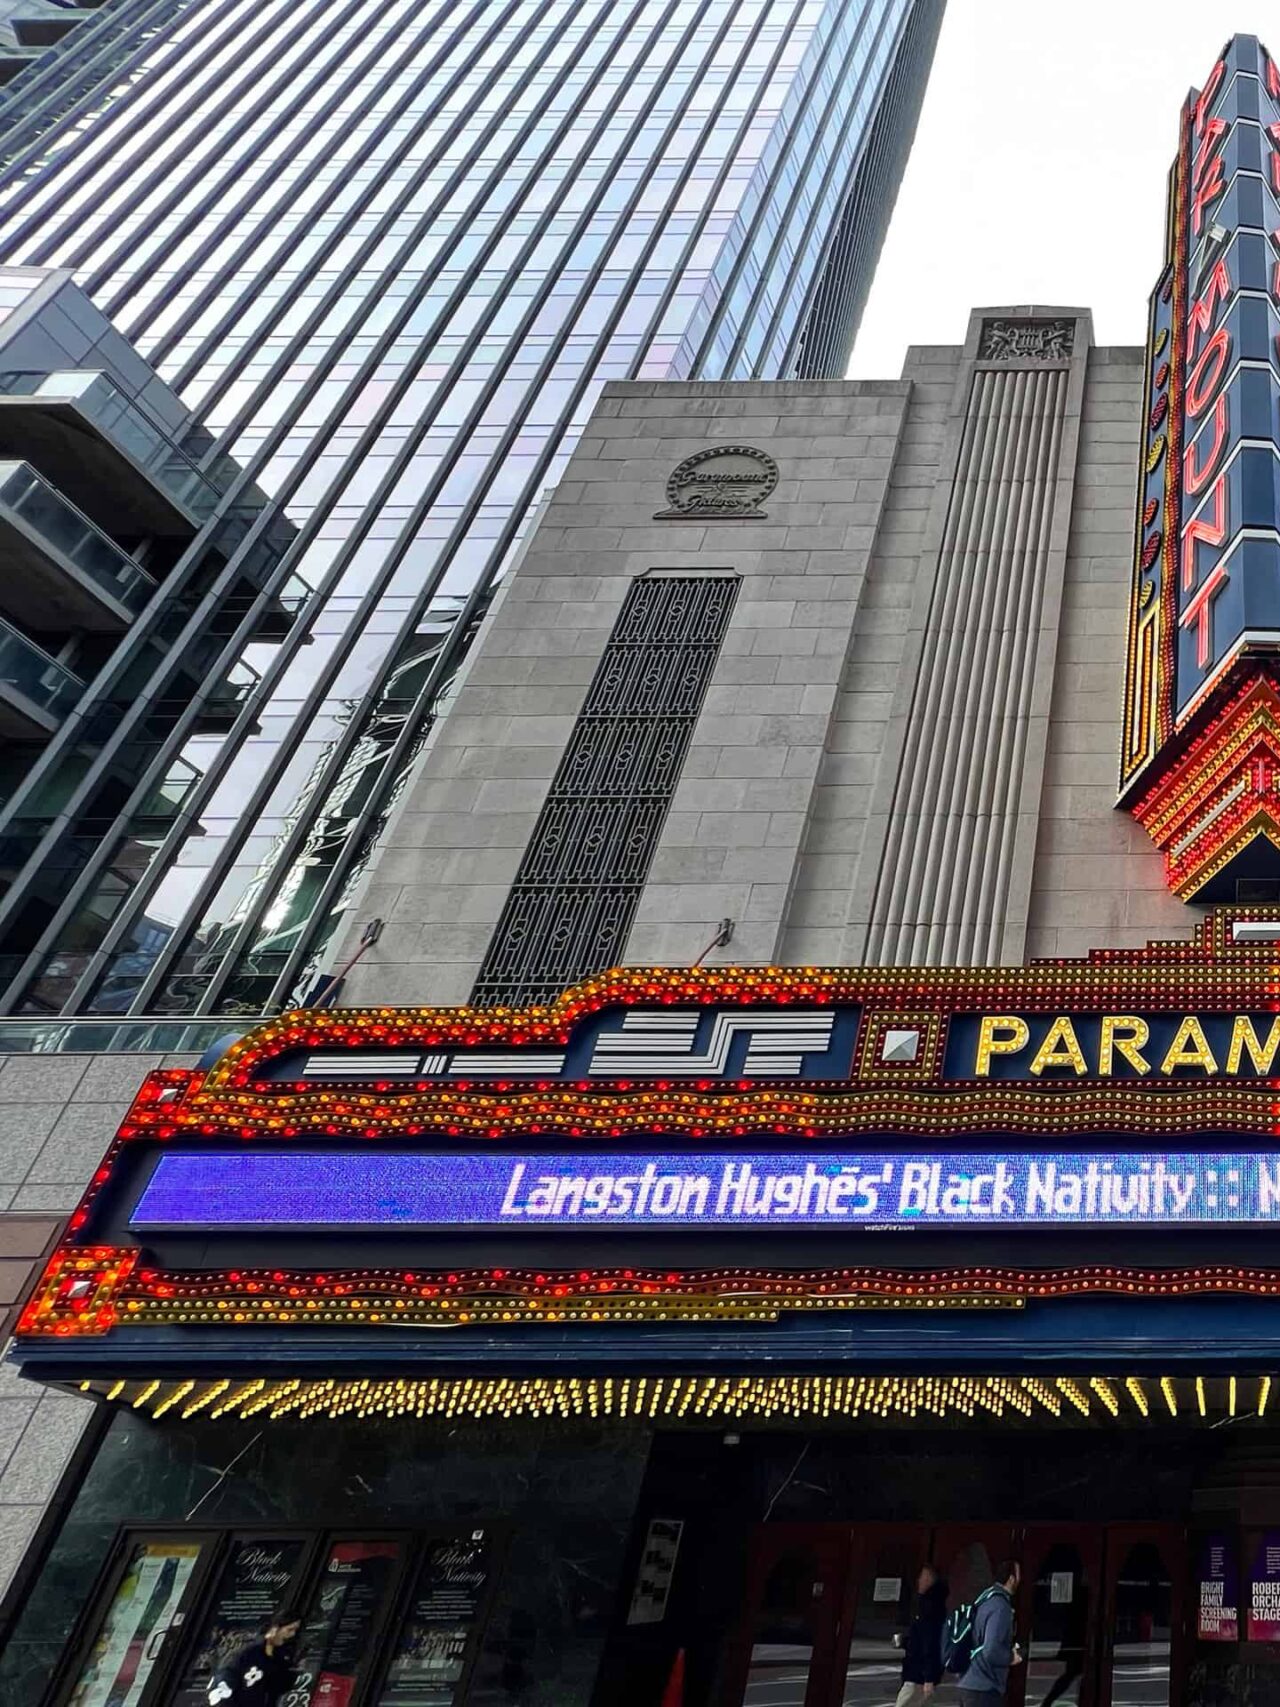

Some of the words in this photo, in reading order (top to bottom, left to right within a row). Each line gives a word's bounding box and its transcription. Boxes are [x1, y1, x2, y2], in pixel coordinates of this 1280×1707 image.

[1178, 57, 1232, 672] PARAMOUNT
[500, 1162, 709, 1215] Langston
[897, 1162, 1015, 1215] Black
[1025, 1161, 1194, 1214] Nativity
[1200, 1581, 1225, 1594] BRIGHT
[1200, 1594, 1223, 1606] FAMILY
[1200, 1607, 1237, 1620] SCREENING
[1200, 1620, 1220, 1633] ROOM
